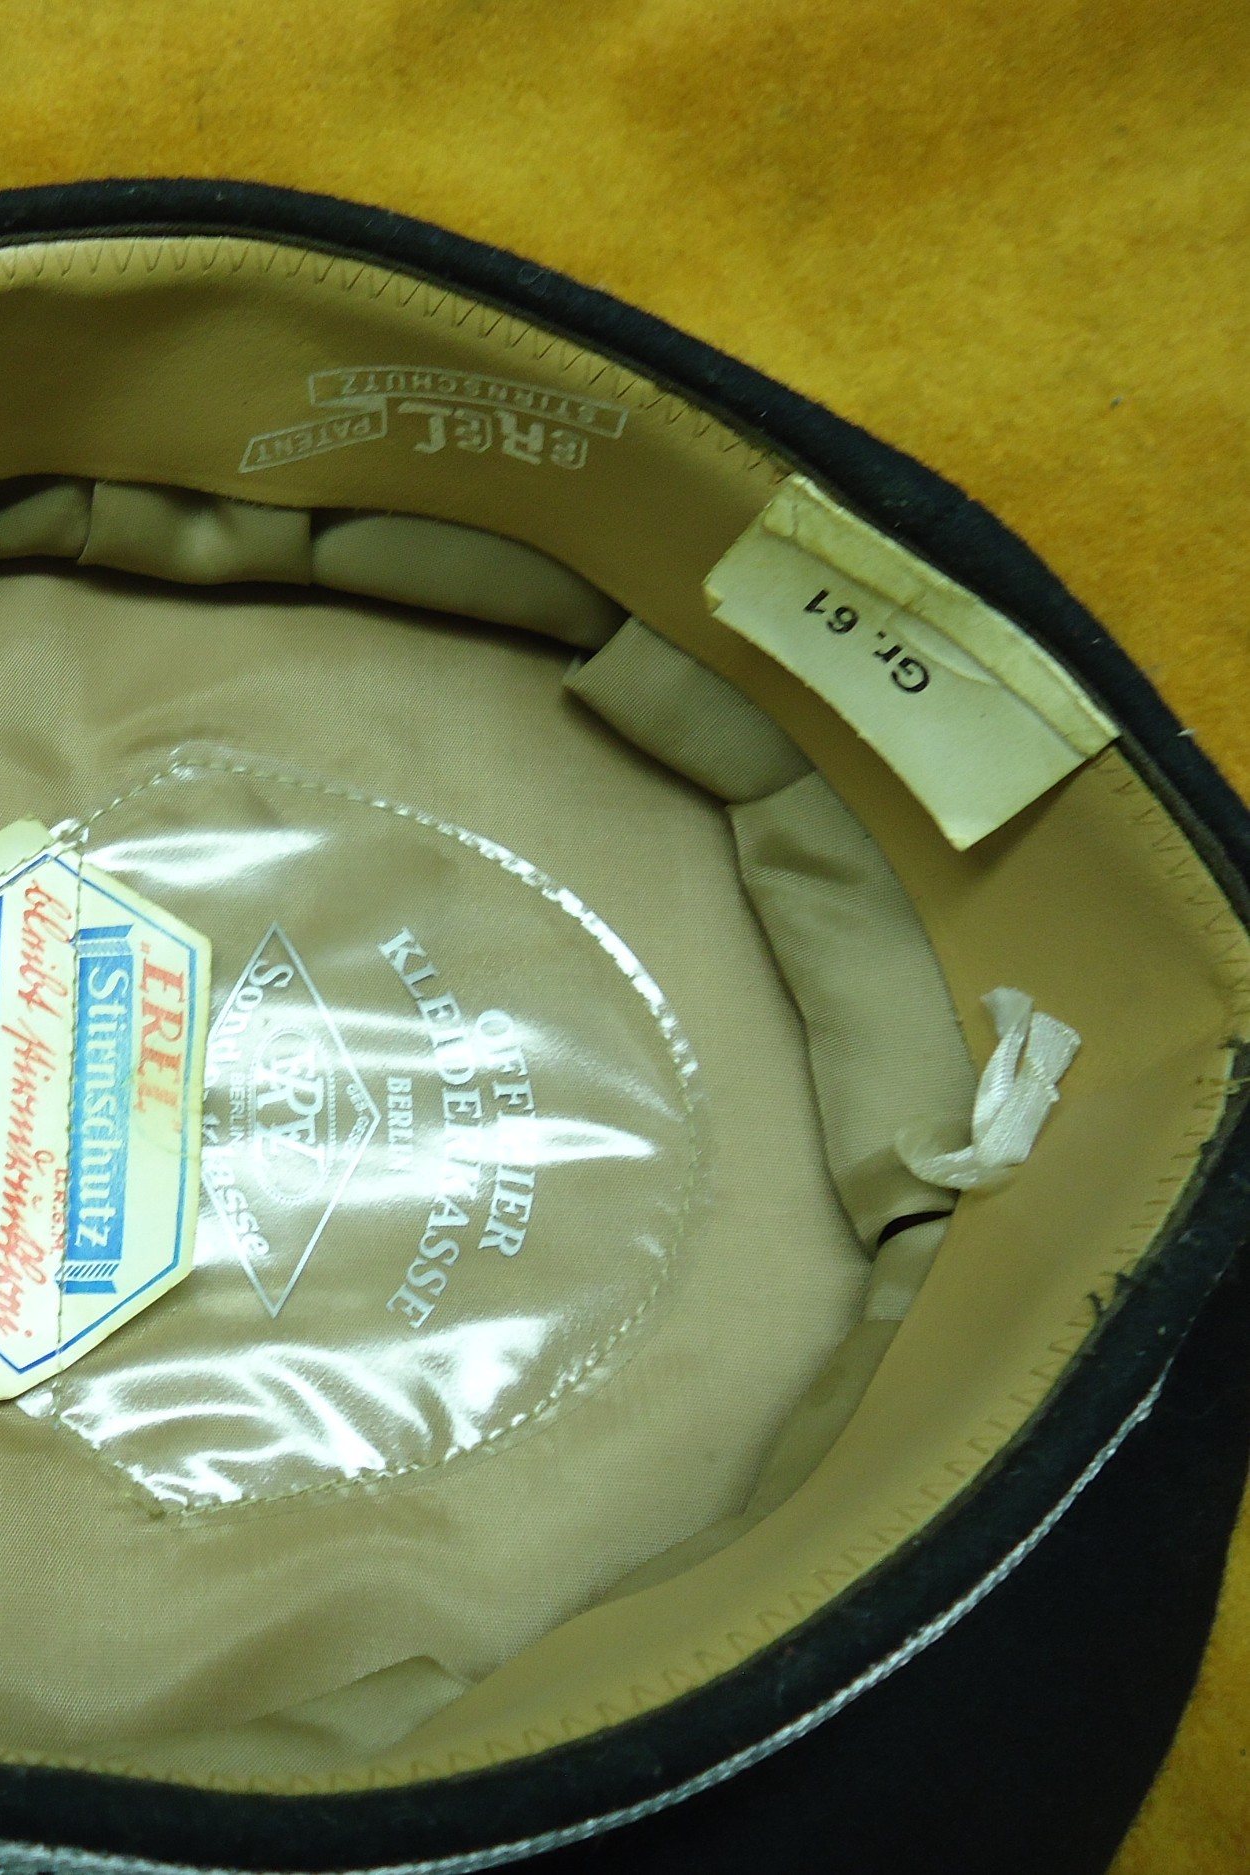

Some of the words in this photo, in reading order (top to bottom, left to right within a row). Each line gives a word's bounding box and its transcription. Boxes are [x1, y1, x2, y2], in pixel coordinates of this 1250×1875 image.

[255, 415, 372, 465] PATENT
[803, 588, 860, 634] 61
[873, 631, 930, 693] Gr.
[74, 965, 129, 1248] Stirnschutz
[478, 1009, 536, 1257] OFFIER
